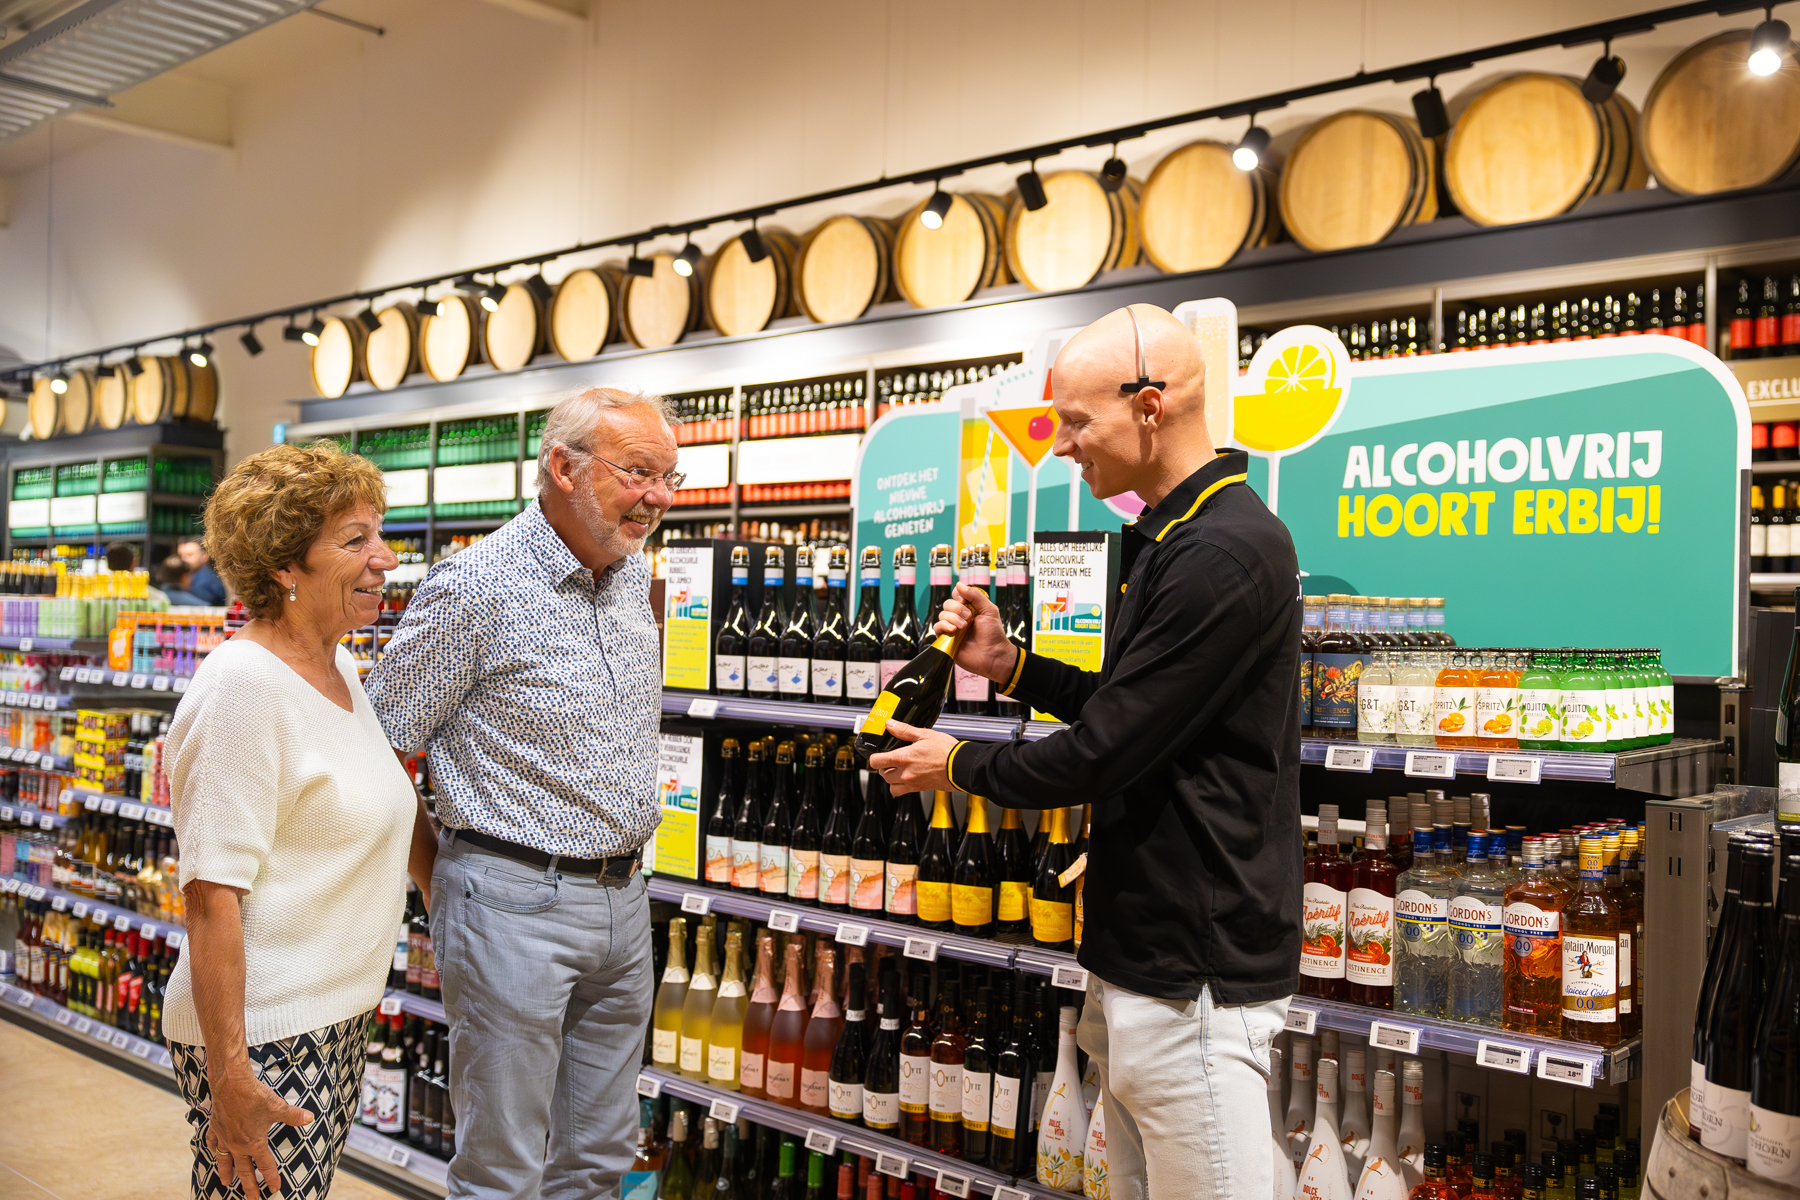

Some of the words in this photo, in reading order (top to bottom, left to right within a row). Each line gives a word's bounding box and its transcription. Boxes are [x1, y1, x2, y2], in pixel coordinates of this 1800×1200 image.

[1342, 430, 1663, 489] ALCOHOLVRIJ
[877, 471, 917, 490] ONTDEK
[918, 467, 939, 483] HET
[889, 485, 927, 505] NIEUWE
[873, 499, 945, 524] ALCOHOLVRIJ
[1337, 491, 1496, 538] HOORT
[1513, 485, 1661, 534] ERBIJ!
[884, 517, 934, 539] GENIETEN
[1039, 543, 1056, 552] ALLES
[1058, 543, 1069, 552] OM
[1071, 543, 1103, 552] HEERLIJKE
[1039, 555, 1085, 565] ALCOHOLVRIJE
[1039, 567, 1077, 577] APERITIEVEN
[1080, 568, 1091, 577] MEE
[1039, 580, 1045, 588] TE
[1047, 580, 1070, 589] MAKEN!
[1361, 698, 1379, 711] G&T
[1399, 699, 1416, 712] G&T
[1478, 702, 1501, 711] SPRITZ
[1521, 702, 1546, 712] MOJITO
[1562, 704, 1587, 713] MOJITO
[707, 847, 724, 861] OA
[734, 852, 753, 865] OA
[761, 856, 777, 870] OA
[1395, 898, 1438, 915] GORDON'S
[1448, 904, 1492, 921] GORDON'S
[1349, 910, 1389, 931] Apéritif
[1504, 911, 1549, 928] GORDON'S
[1515, 940, 1531, 952] 0.0
[1586, 941, 1615, 956] Morgan
[1565, 984, 1589, 996] Spiced
[1591, 988, 1610, 998] Gold
[1576, 997, 1595, 1010] 0.0
[1294, 1062, 1308, 1071] DOLCE
[1319, 1090, 1330, 1099] VITA
[1405, 1085, 1420, 1094] DOLCE
[1048, 1118, 1061, 1128] DOLCE
[1054, 1128, 1065, 1137] VITA
[1091, 1130, 1103, 1140] DOLCE
[1096, 1139, 1107, 1149] VITA
[1750, 1137, 1791, 1160] THORN
[1302, 1184, 1319, 1196] DOLCE
